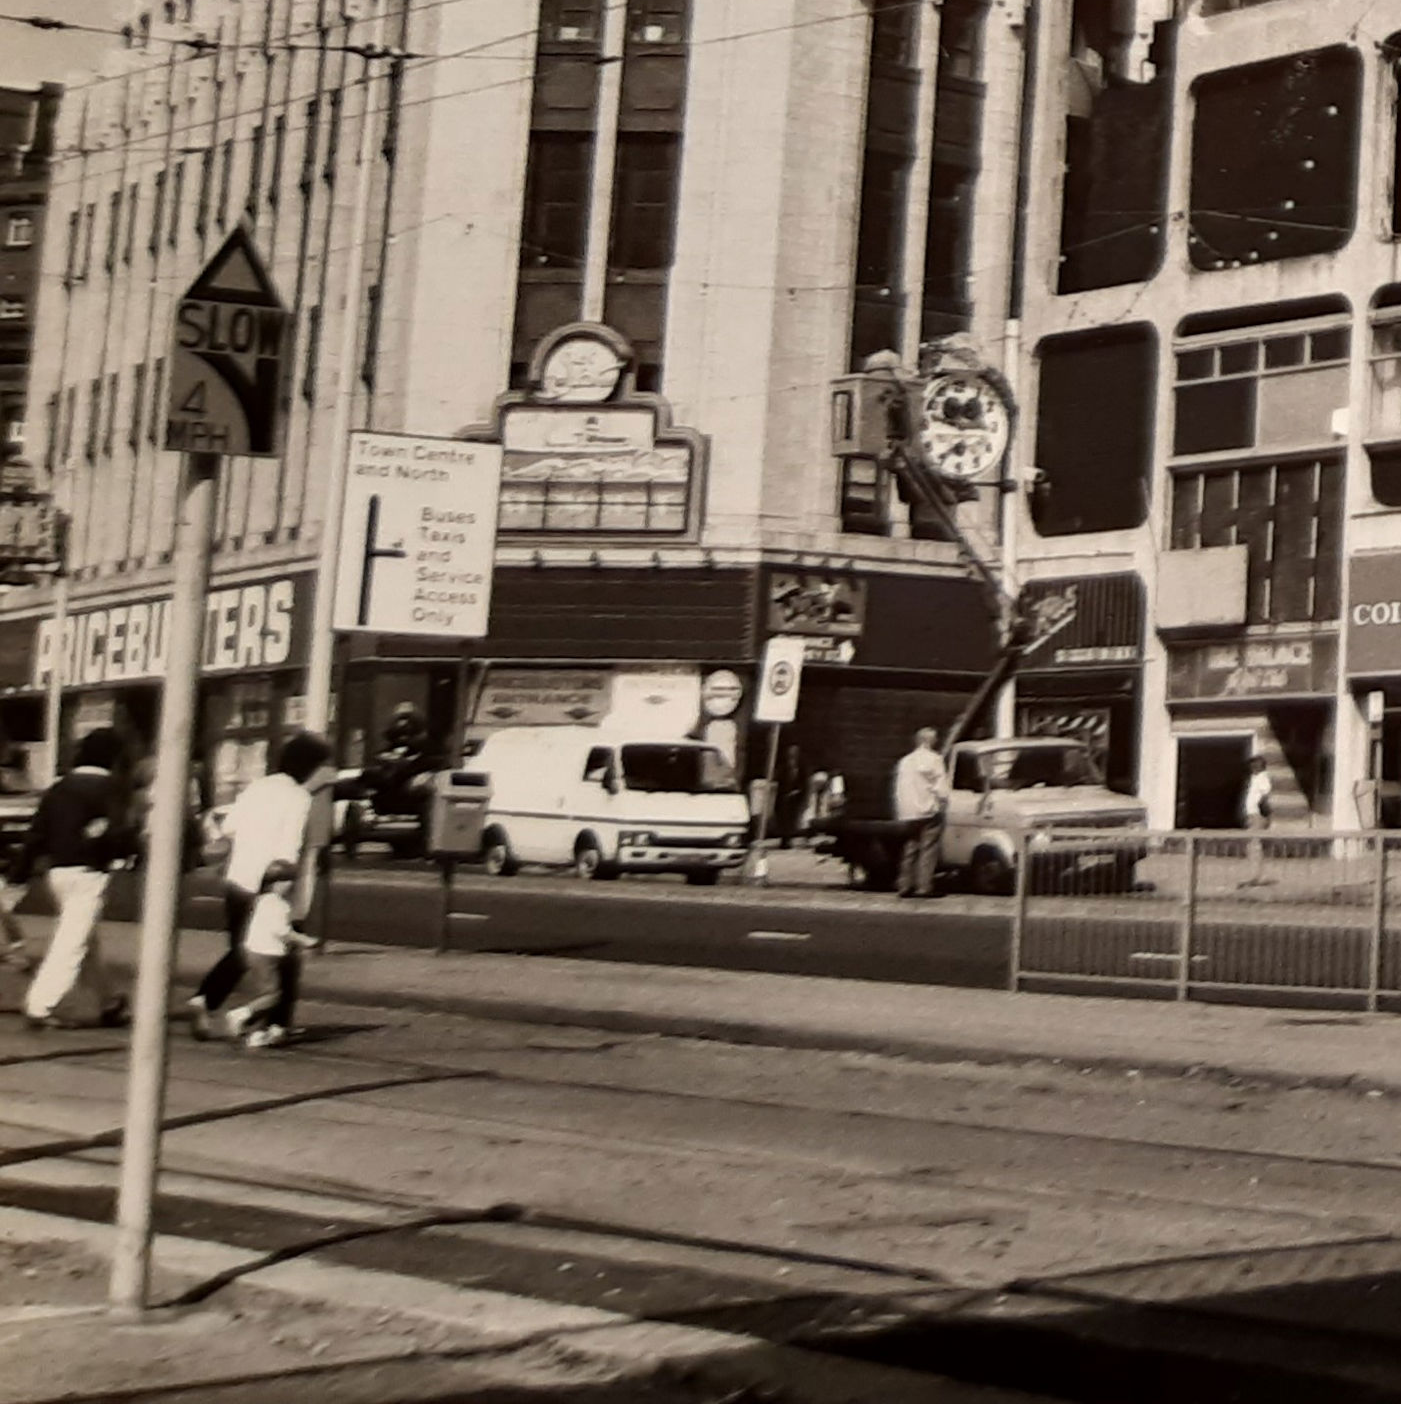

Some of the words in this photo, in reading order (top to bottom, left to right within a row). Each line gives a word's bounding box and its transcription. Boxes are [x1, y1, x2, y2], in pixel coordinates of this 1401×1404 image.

[178, 302, 284, 356] SLOW
[359, 440, 407, 457] Town
[413, 446, 475, 464] Centre
[356, 464, 390, 477] and
[396, 466, 450, 481] North
[421, 507, 476, 524] Buses
[416, 550, 451, 562] and
[416, 567, 483, 584] Service
[414, 588, 478, 605] Access
[412, 607, 455, 626] Only
